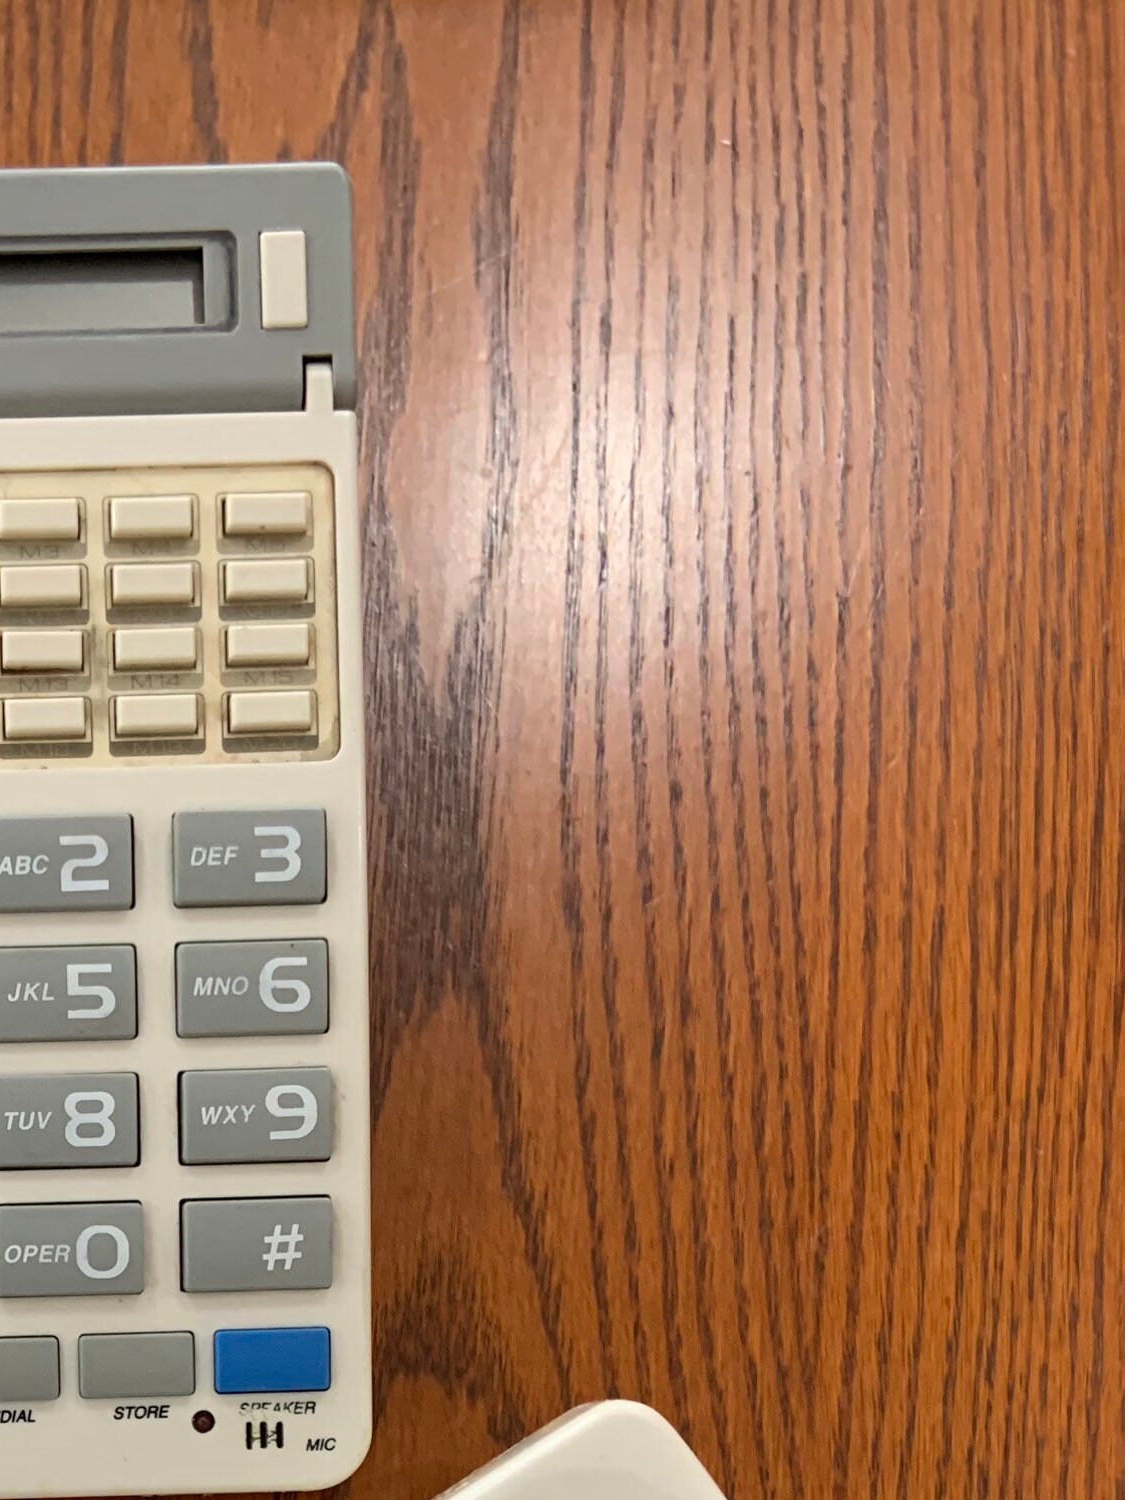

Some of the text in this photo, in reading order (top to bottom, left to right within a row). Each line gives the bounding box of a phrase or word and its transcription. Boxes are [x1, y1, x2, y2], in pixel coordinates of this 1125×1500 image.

[19, 677, 69, 692] M13
[130, 674, 181, 689] M14
[243, 671, 294, 685] M15
[58, 834, 110, 892] 2
[190, 825, 302, 883] DEF 3
[7, 962, 116, 1019] JKL 5
[193, 956, 311, 1013] MNO 6
[3, 1090, 116, 1147] TUV 8
[201, 1084, 318, 1141] WXY 9
[4, 1244, 71, 1264] OPER
[113, 1404, 171, 1421] STORE
[305, 1437, 337, 1452] MIC
